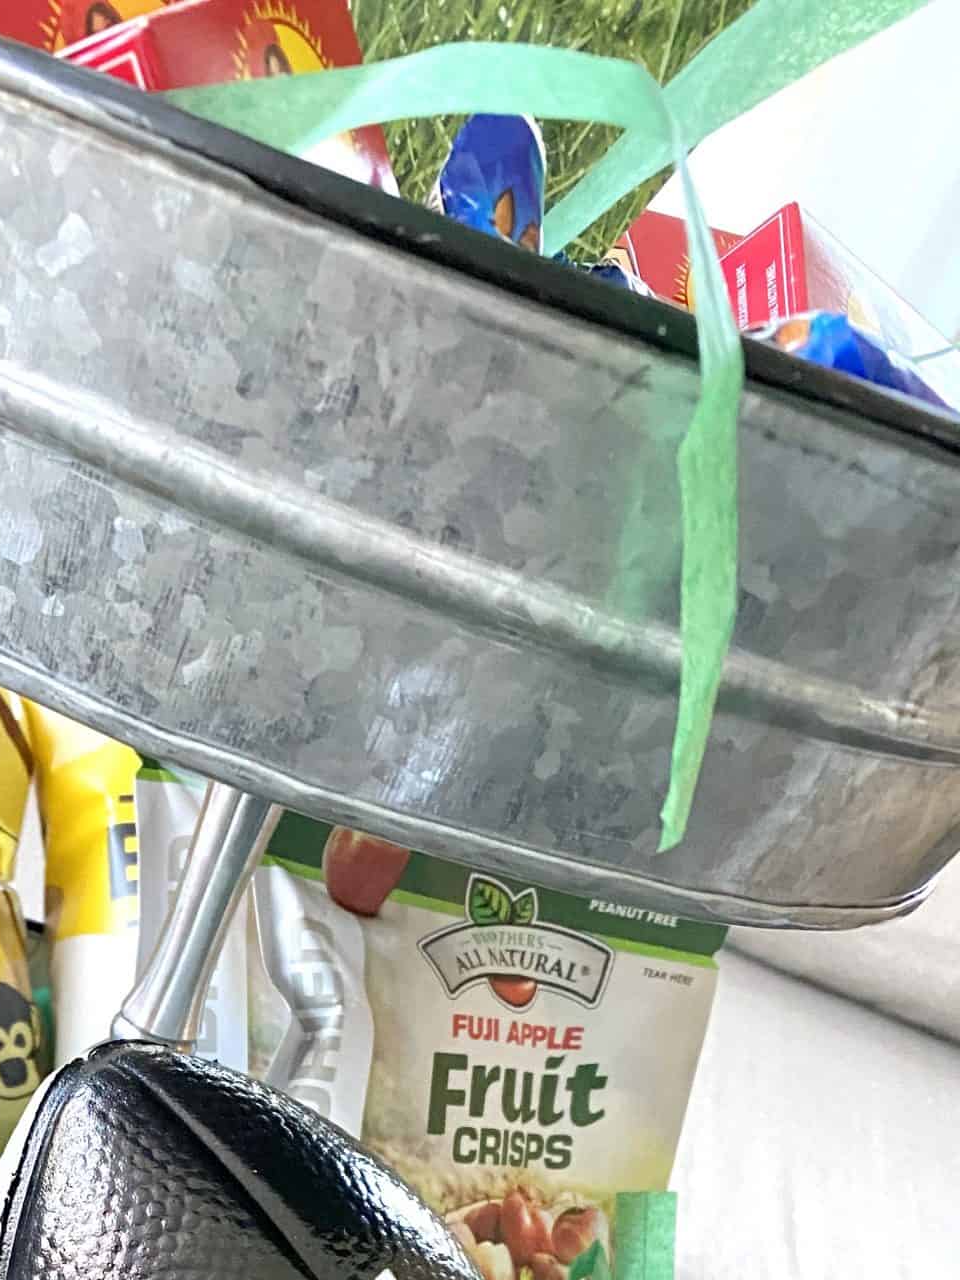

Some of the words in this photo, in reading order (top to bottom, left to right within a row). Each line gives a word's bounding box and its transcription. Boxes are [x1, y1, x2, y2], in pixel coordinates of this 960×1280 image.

[588, 899, 645, 922] PEANUT
[646, 911, 678, 928] FREE
[455, 949, 488, 976] ALL
[489, 948, 578, 985] NATURAL
[451, 1013, 500, 1043] FUJI
[506, 1020, 585, 1051] APPLE
[426, 1051, 609, 1136] Fruit
[452, 1126, 574, 1171] CRISPS
